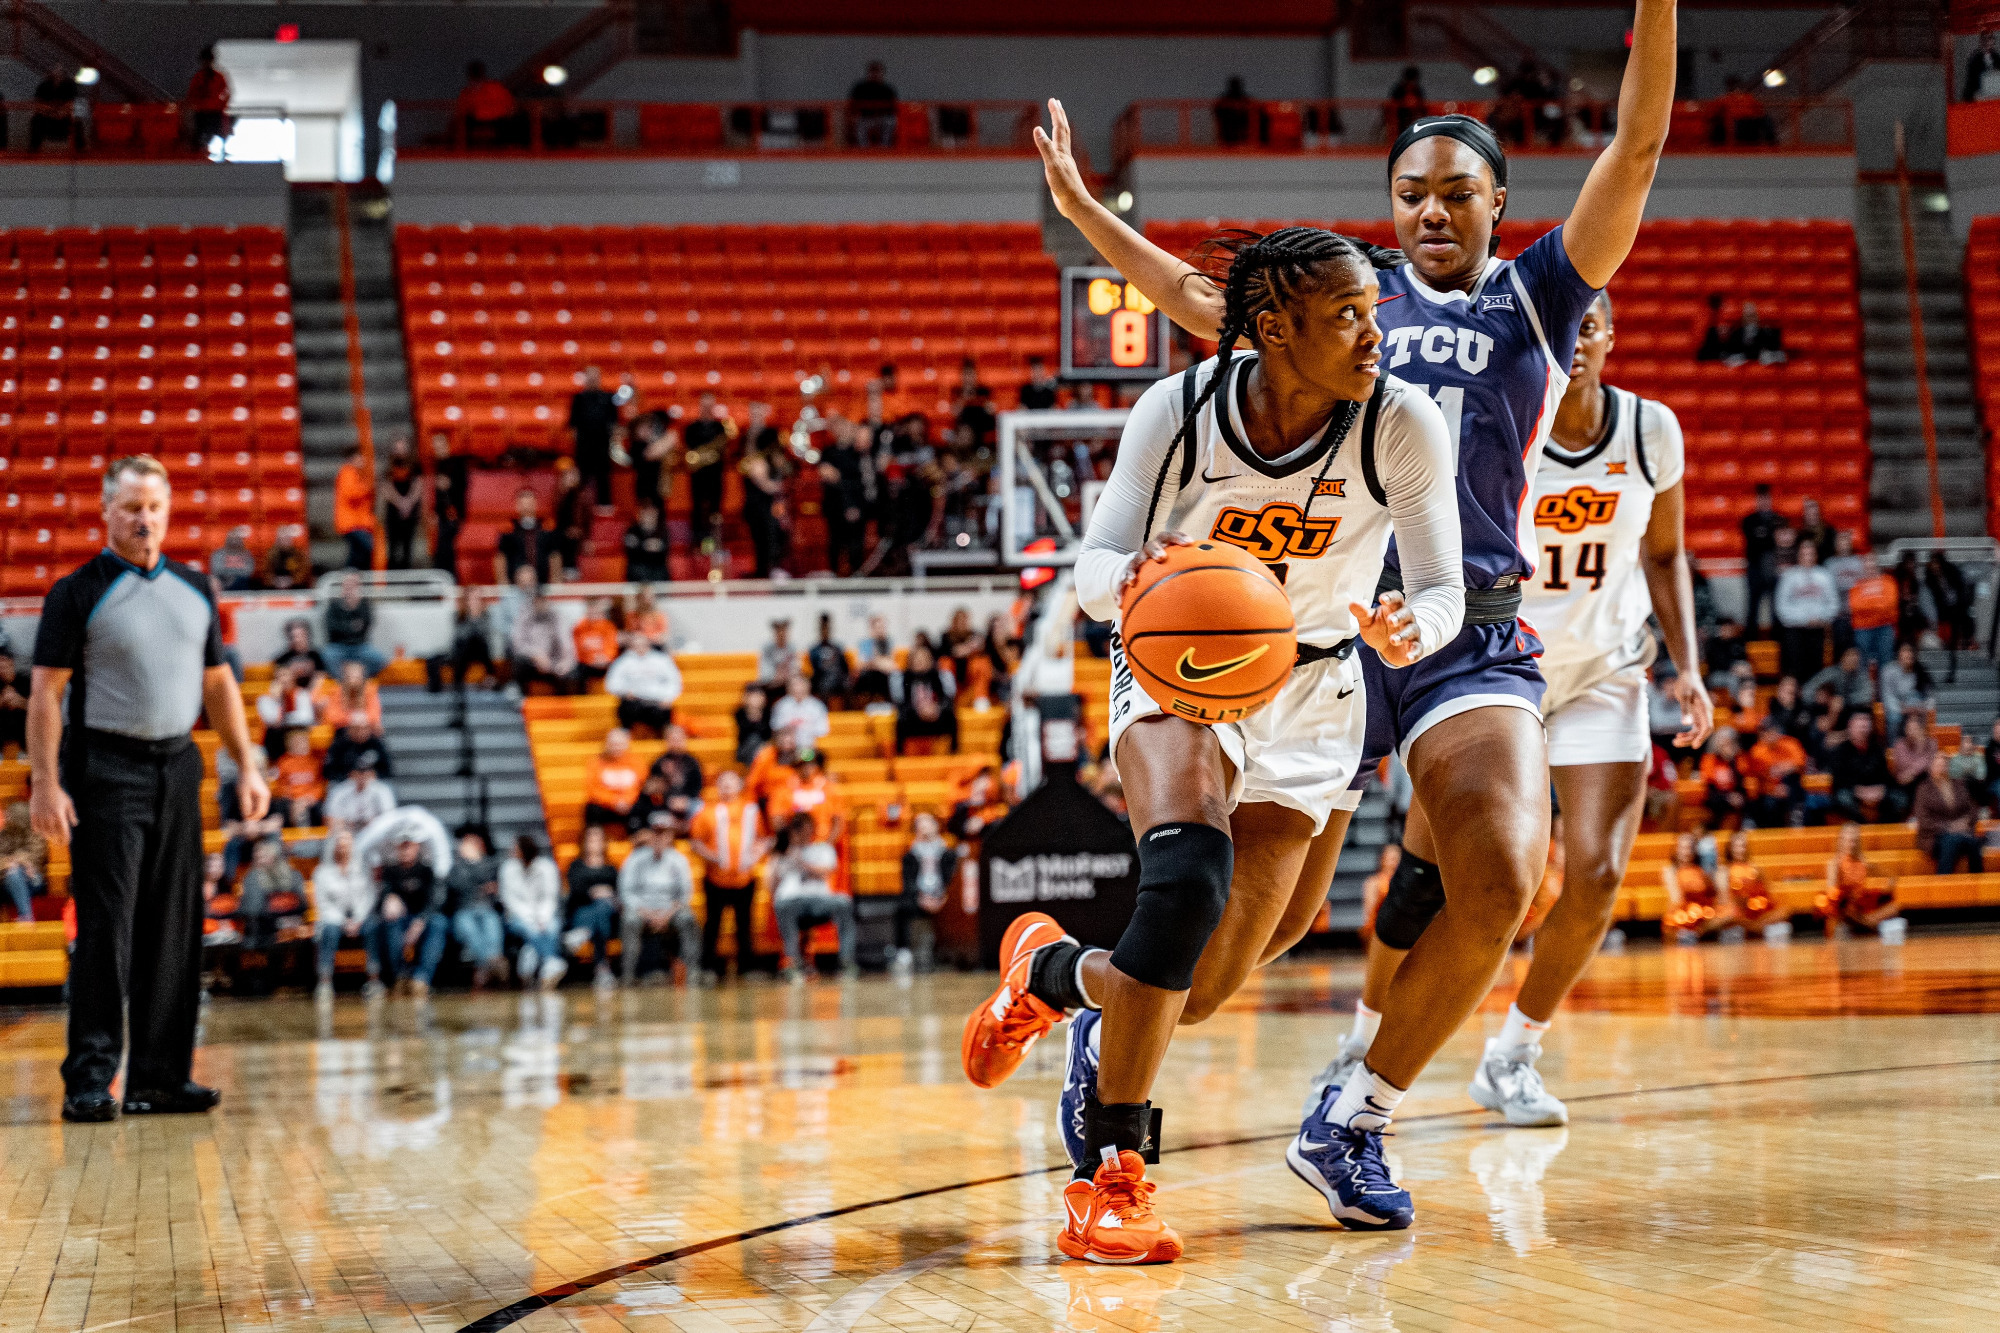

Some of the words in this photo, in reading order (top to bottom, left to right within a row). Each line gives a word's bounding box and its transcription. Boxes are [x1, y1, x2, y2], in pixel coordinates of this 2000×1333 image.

[1110, 309, 1148, 367] 8
[1386, 325, 1494, 375] TCU
[1208, 502, 1342, 563] OSU
[1534, 485, 1621, 534] OSU
[1543, 542, 1606, 592] 14
